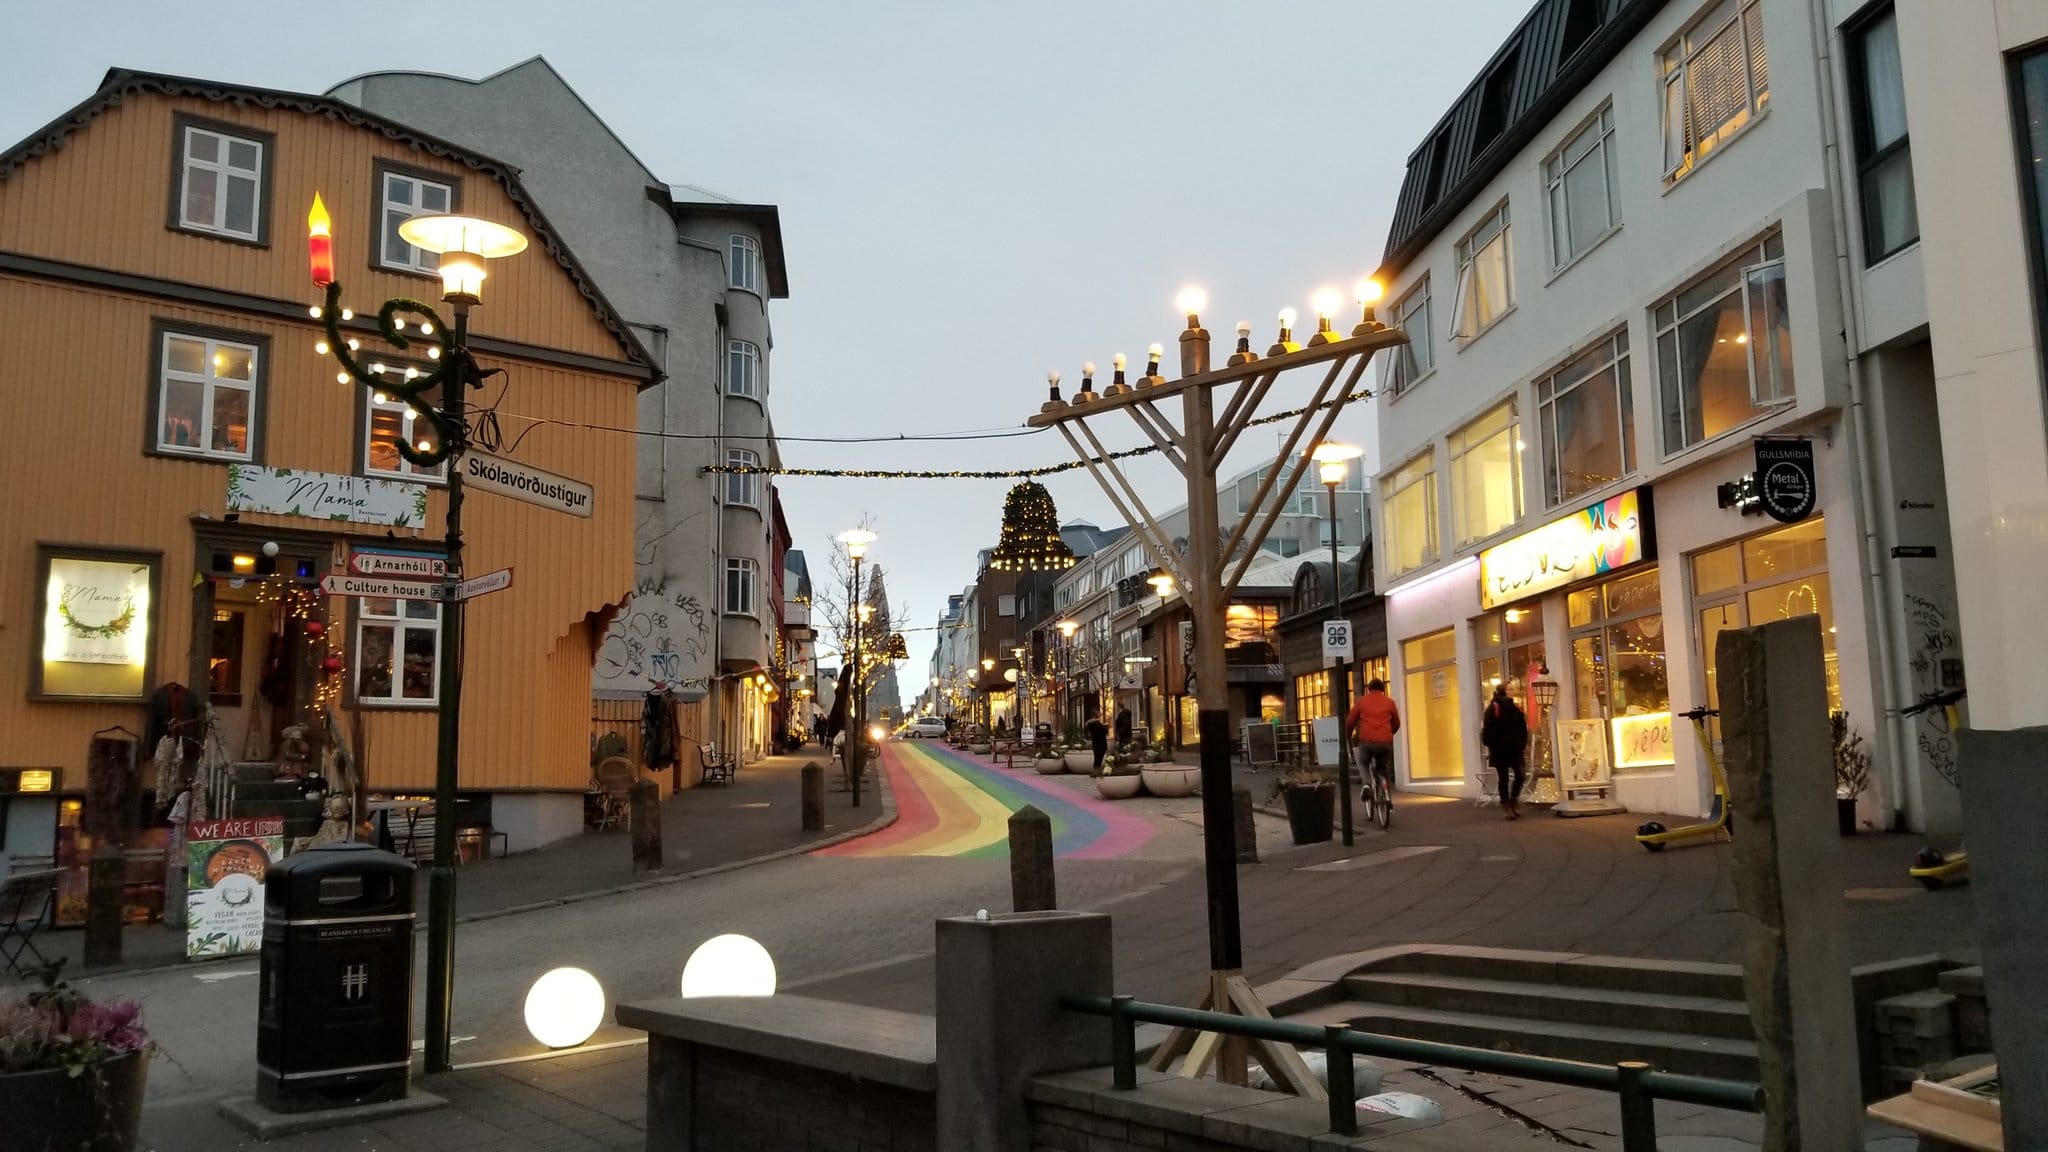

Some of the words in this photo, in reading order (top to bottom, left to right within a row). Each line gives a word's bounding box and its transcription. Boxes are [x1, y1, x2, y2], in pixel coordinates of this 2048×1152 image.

[469, 457, 588, 508] Skólavörðustígur
[1772, 473, 1799, 484] Metal
[286, 477, 369, 512] Mama
[374, 558, 428, 573] Arnarhóll
[70, 584, 122, 605] Mama
[344, 580, 389, 594] Culture
[392, 581, 426, 597] house
[194, 823, 220, 838] WE
[223, 821, 251, 838] ARE
